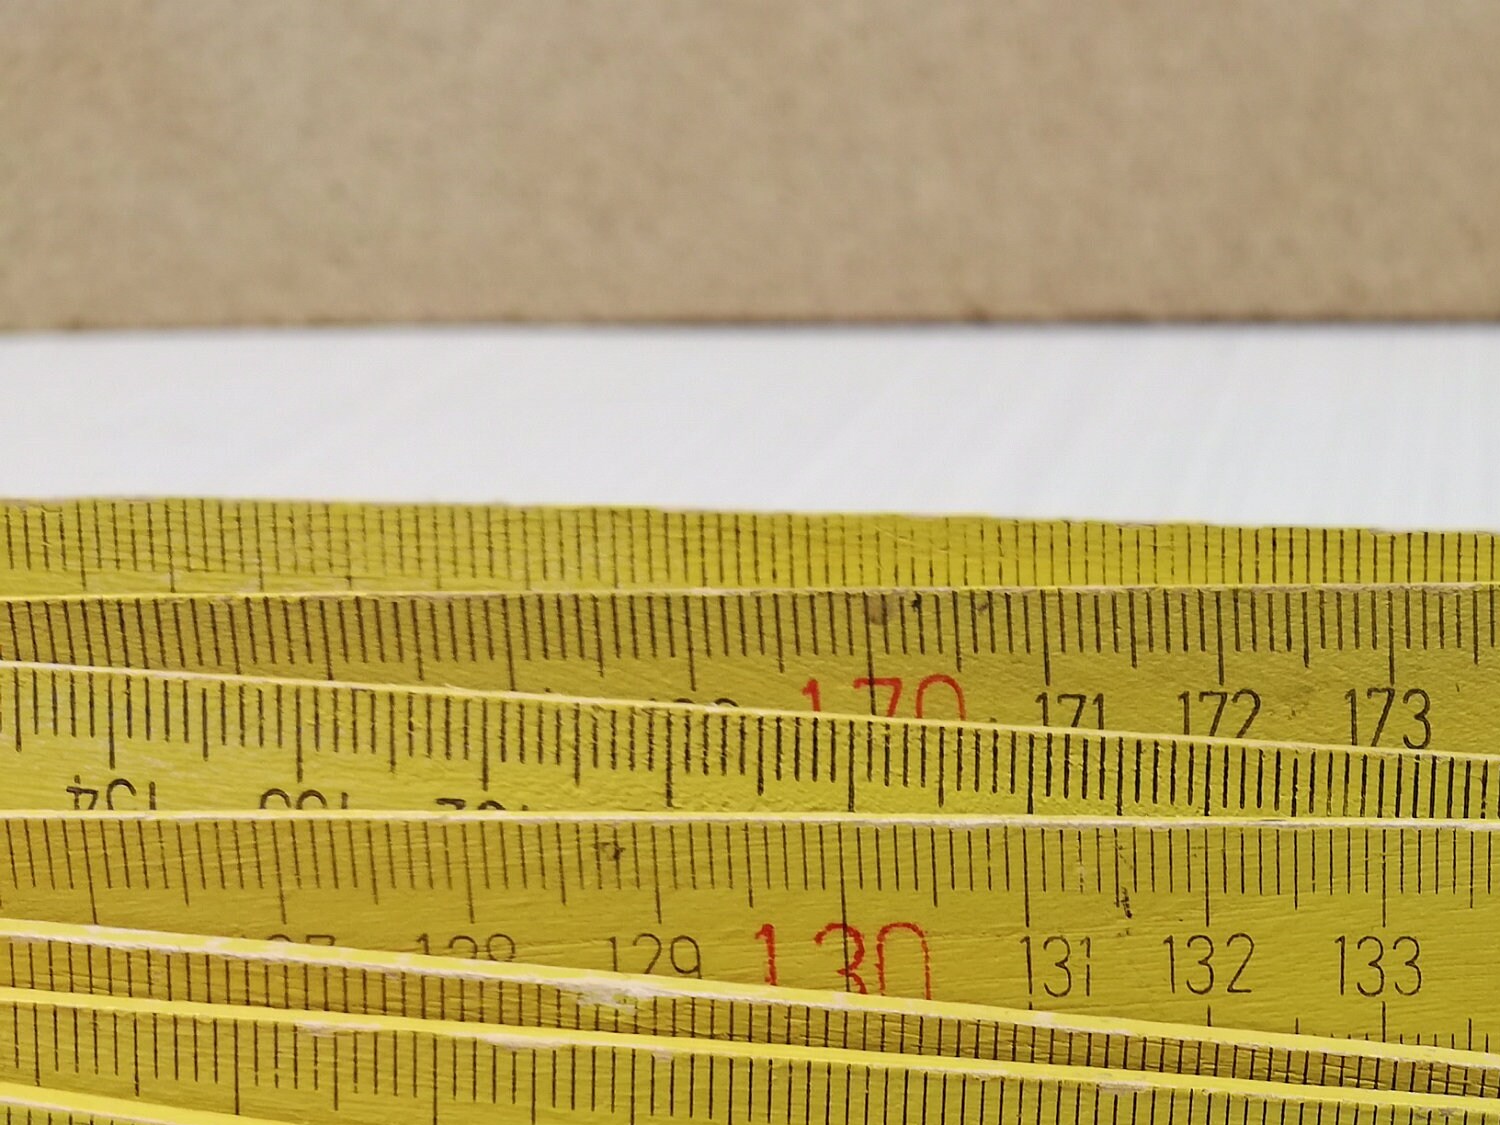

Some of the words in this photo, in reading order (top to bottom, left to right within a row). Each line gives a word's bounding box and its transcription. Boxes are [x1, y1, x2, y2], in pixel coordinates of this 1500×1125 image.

[1177, 689, 1261, 738] 172
[1344, 687, 1431, 750] 173
[755, 922, 931, 1000] 130
[1018, 935, 1093, 997] 131
[1163, 933, 1255, 994] 132
[1334, 935, 1422, 997] 133
